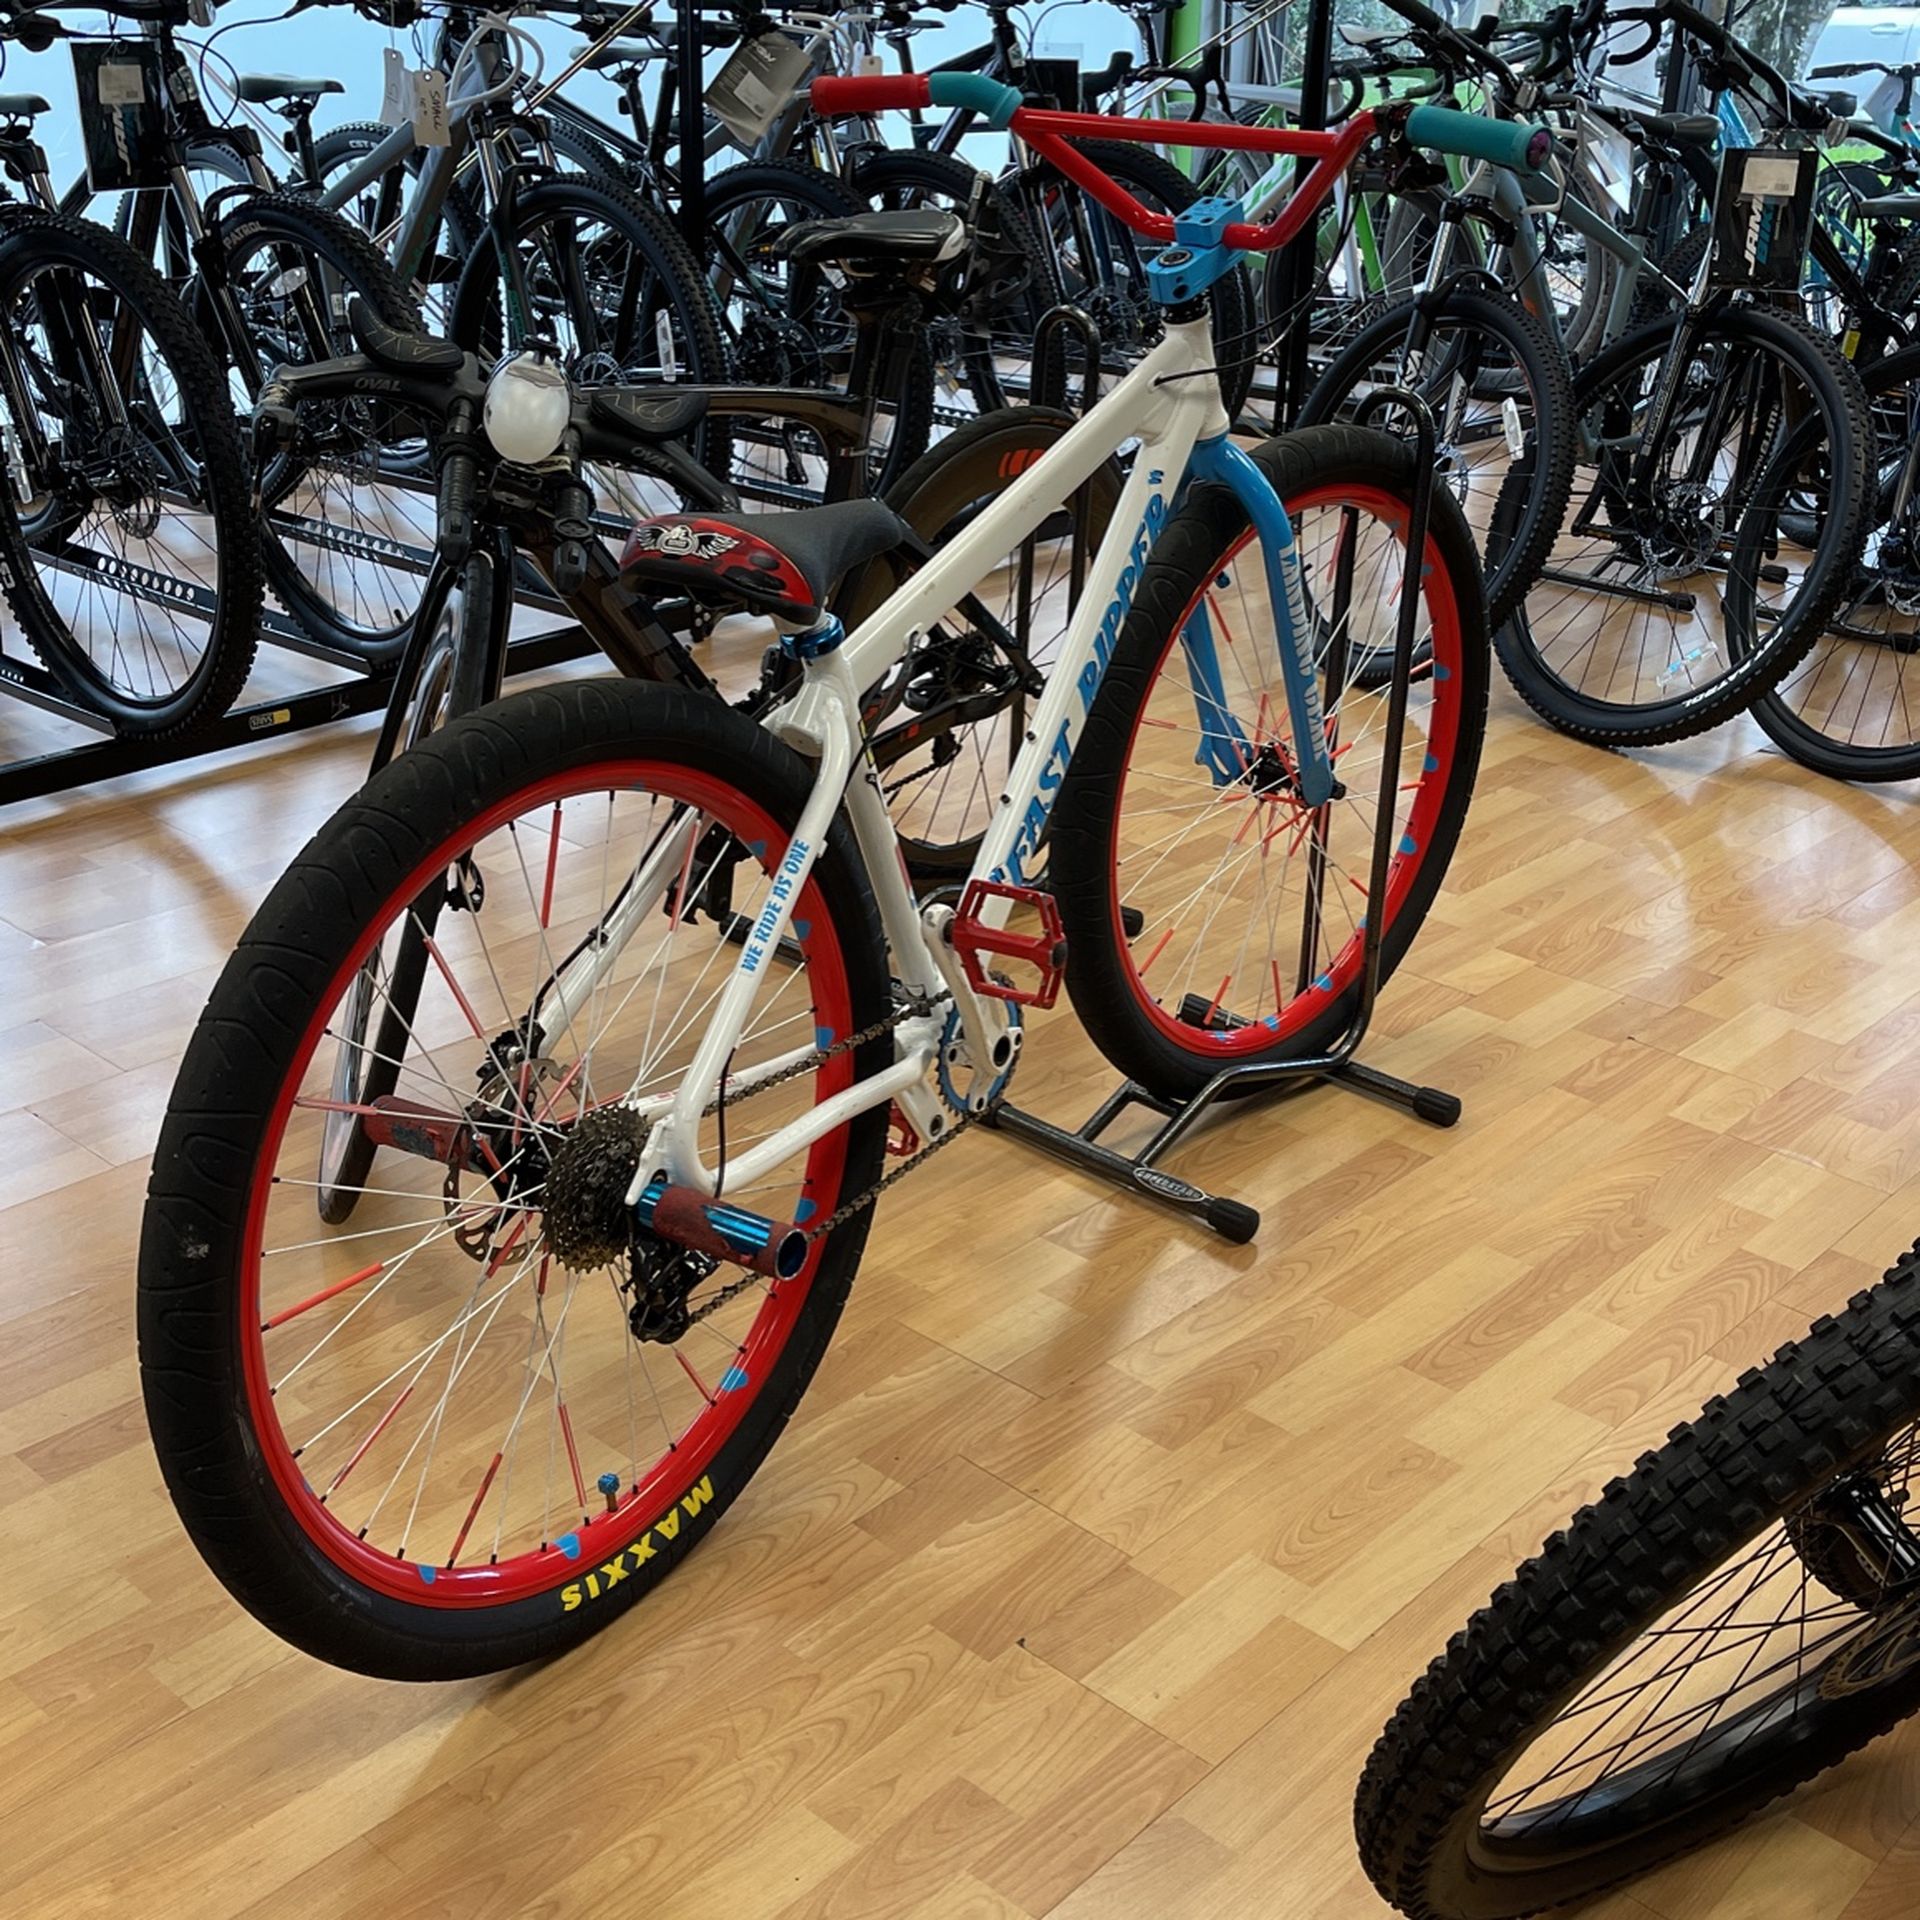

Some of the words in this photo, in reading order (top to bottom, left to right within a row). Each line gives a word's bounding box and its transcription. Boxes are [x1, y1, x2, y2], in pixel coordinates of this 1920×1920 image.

[112, 103, 132, 176] JAM
[223, 220, 268, 250] PATROL
[1744, 194, 1764, 276] JAM
[354, 377, 402, 392] OVAL
[631, 446, 674, 473] OVAL
[1279, 543, 1314, 677] LANDING
[741, 943, 764, 972] WE
[755, 901, 783, 943] RIDE
[773, 875, 793, 900] AS
[784, 839, 811, 875] ONE
[560, 1474, 715, 1612] MAXXIS
